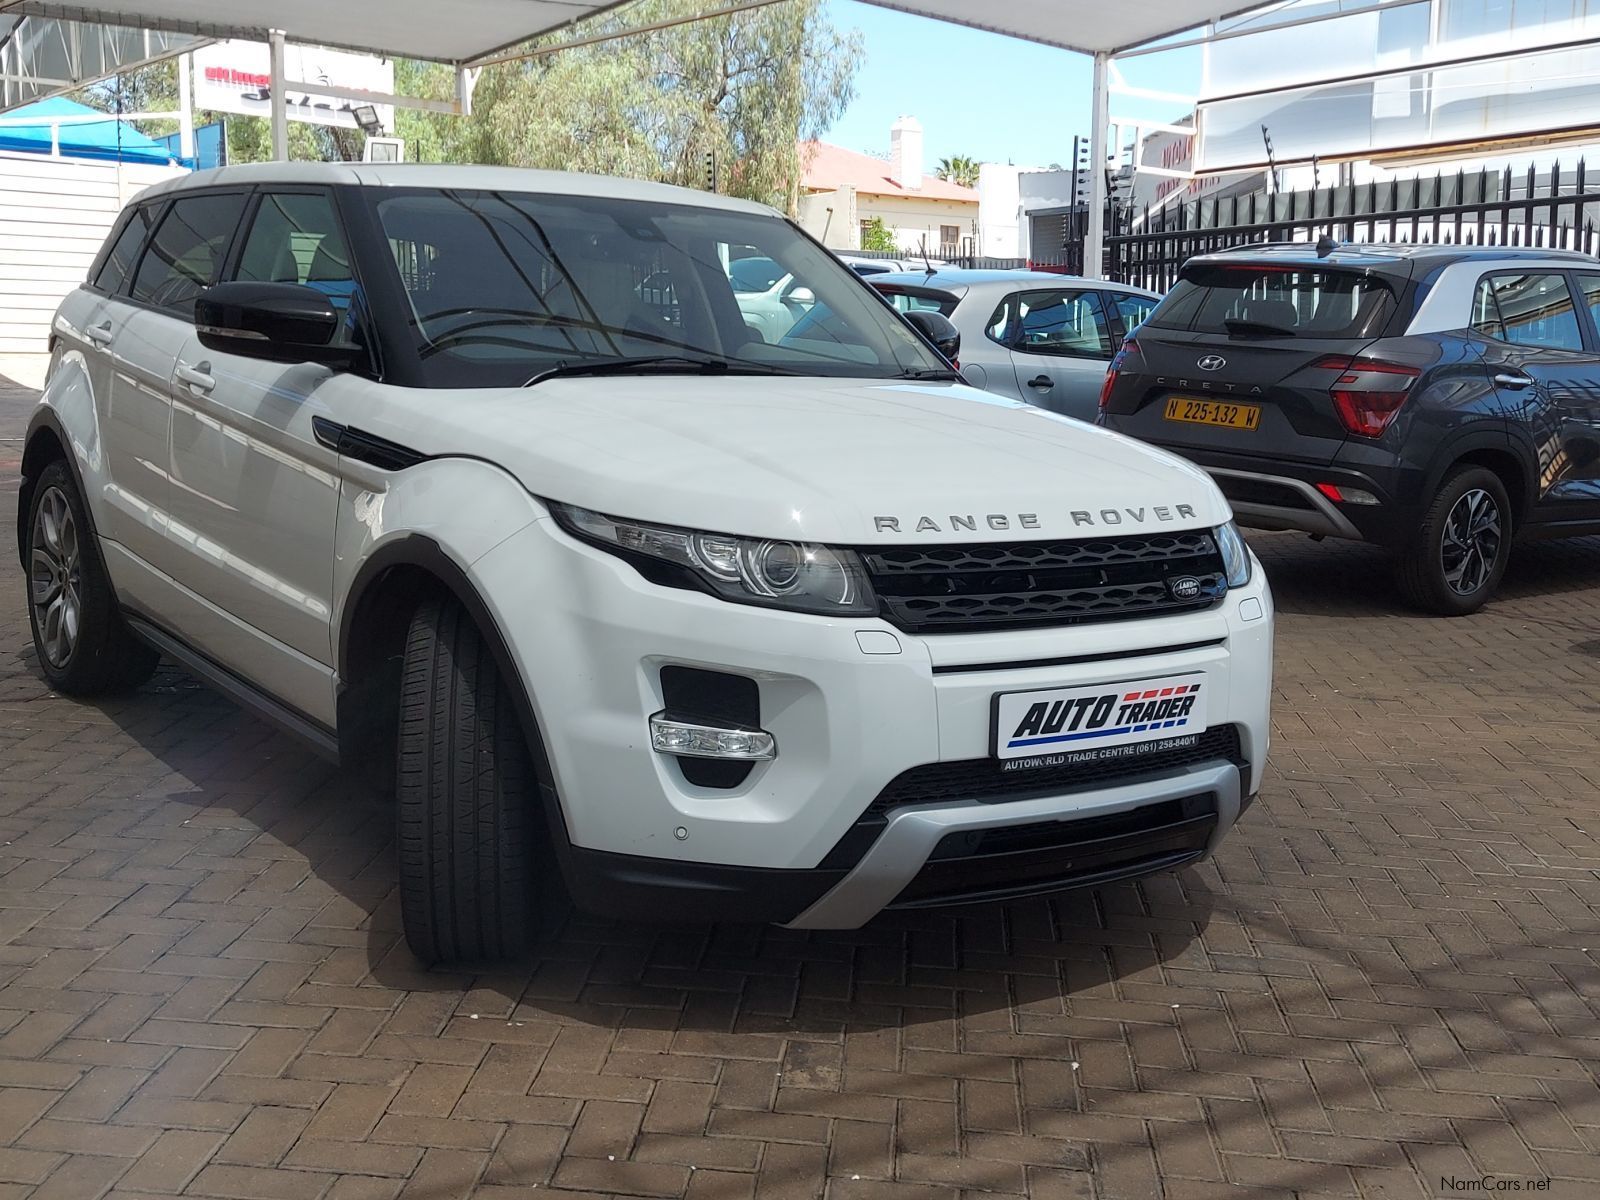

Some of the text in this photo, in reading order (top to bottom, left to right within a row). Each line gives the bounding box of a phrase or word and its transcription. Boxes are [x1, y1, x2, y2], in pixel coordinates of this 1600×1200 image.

[1157, 377, 1262, 393] CRETA
[1168, 400, 1257, 427] N 225-132 W
[873, 503, 1197, 533] RANGE ROVER
[1012, 694, 1196, 738] AUTO TRADER
[1067, 751, 1098, 763] TRADE
[1099, 745, 1135, 759] CENTRE
[1136, 742, 1157, 755] (061)
